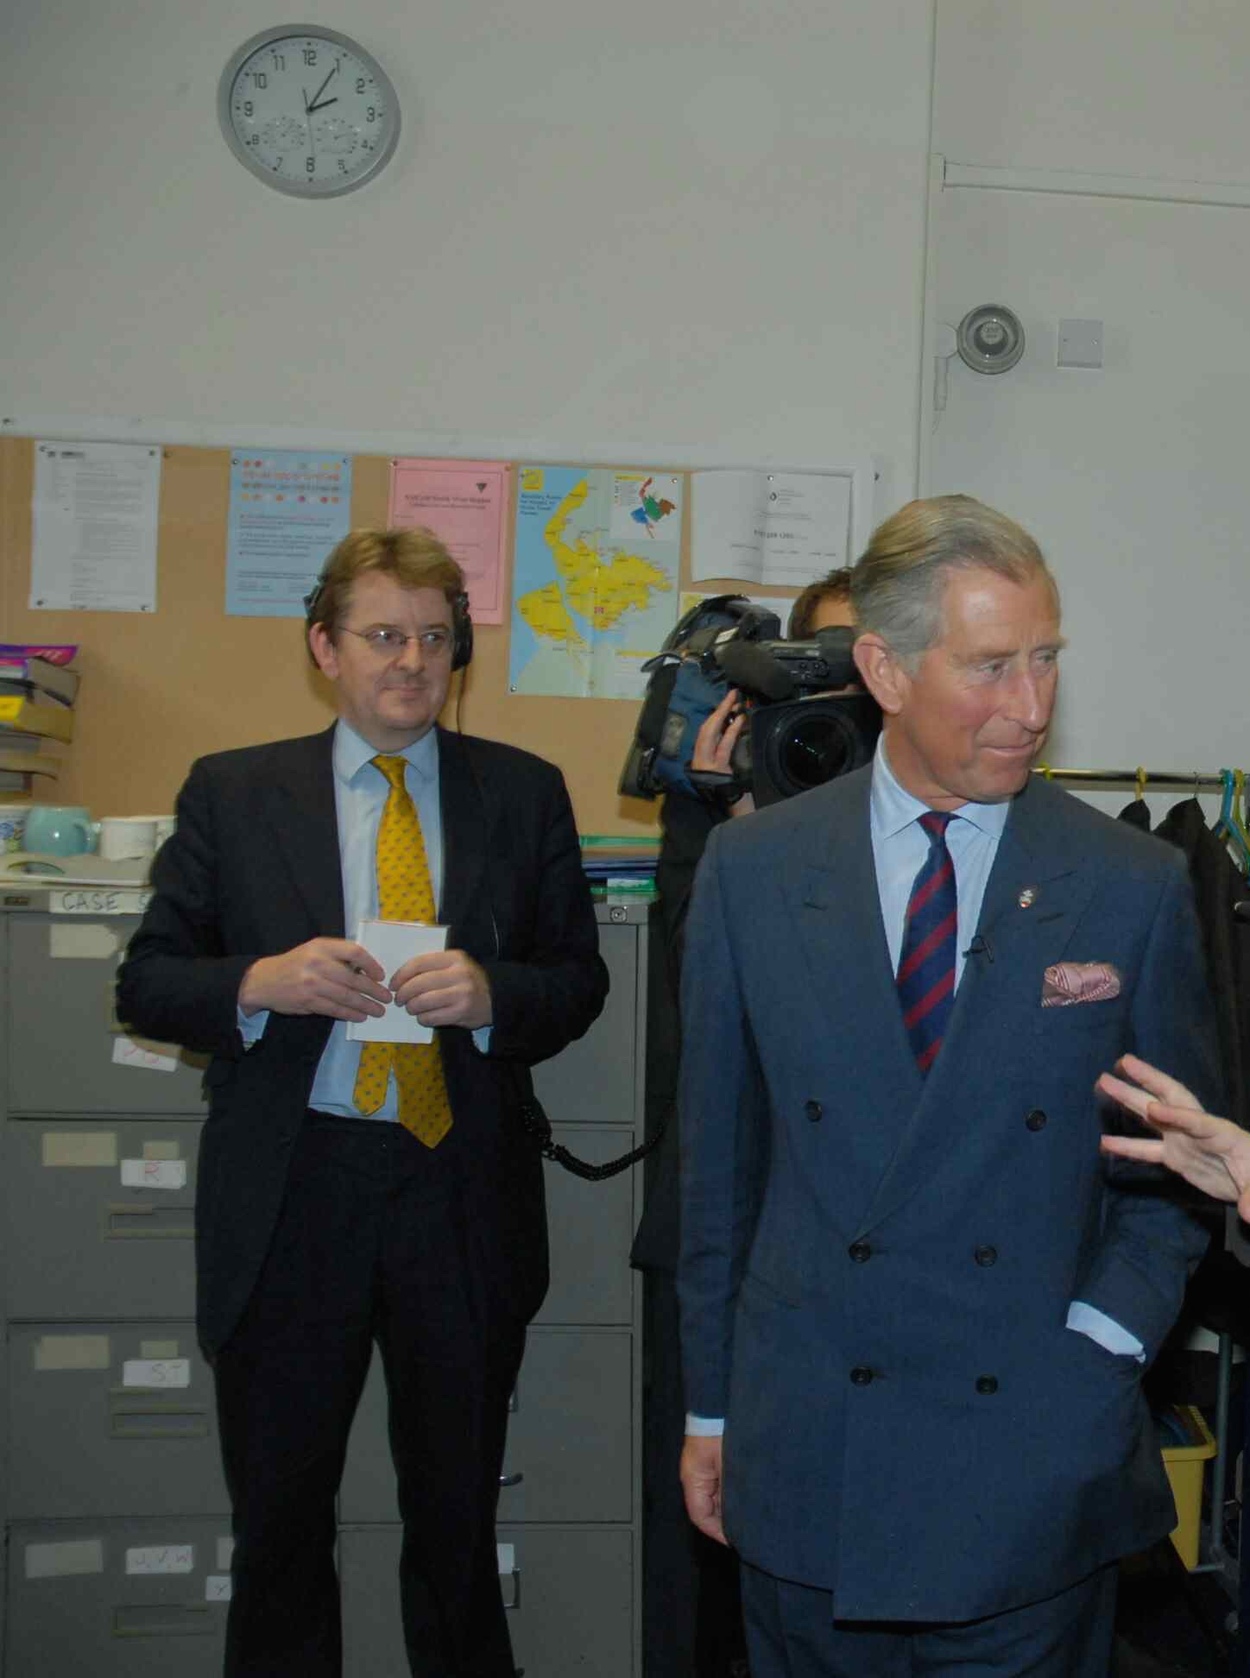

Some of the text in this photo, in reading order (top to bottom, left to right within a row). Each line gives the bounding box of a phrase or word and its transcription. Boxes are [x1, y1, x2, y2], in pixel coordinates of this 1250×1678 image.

[273, 55, 286, 71] 11
[301, 49, 317, 67] 12
[252, 72, 268, 90] 10
[355, 78, 366, 95] 2
[243, 101, 254, 118] 9
[366, 106, 376, 123] 3
[62, 891, 121, 912] CASE
